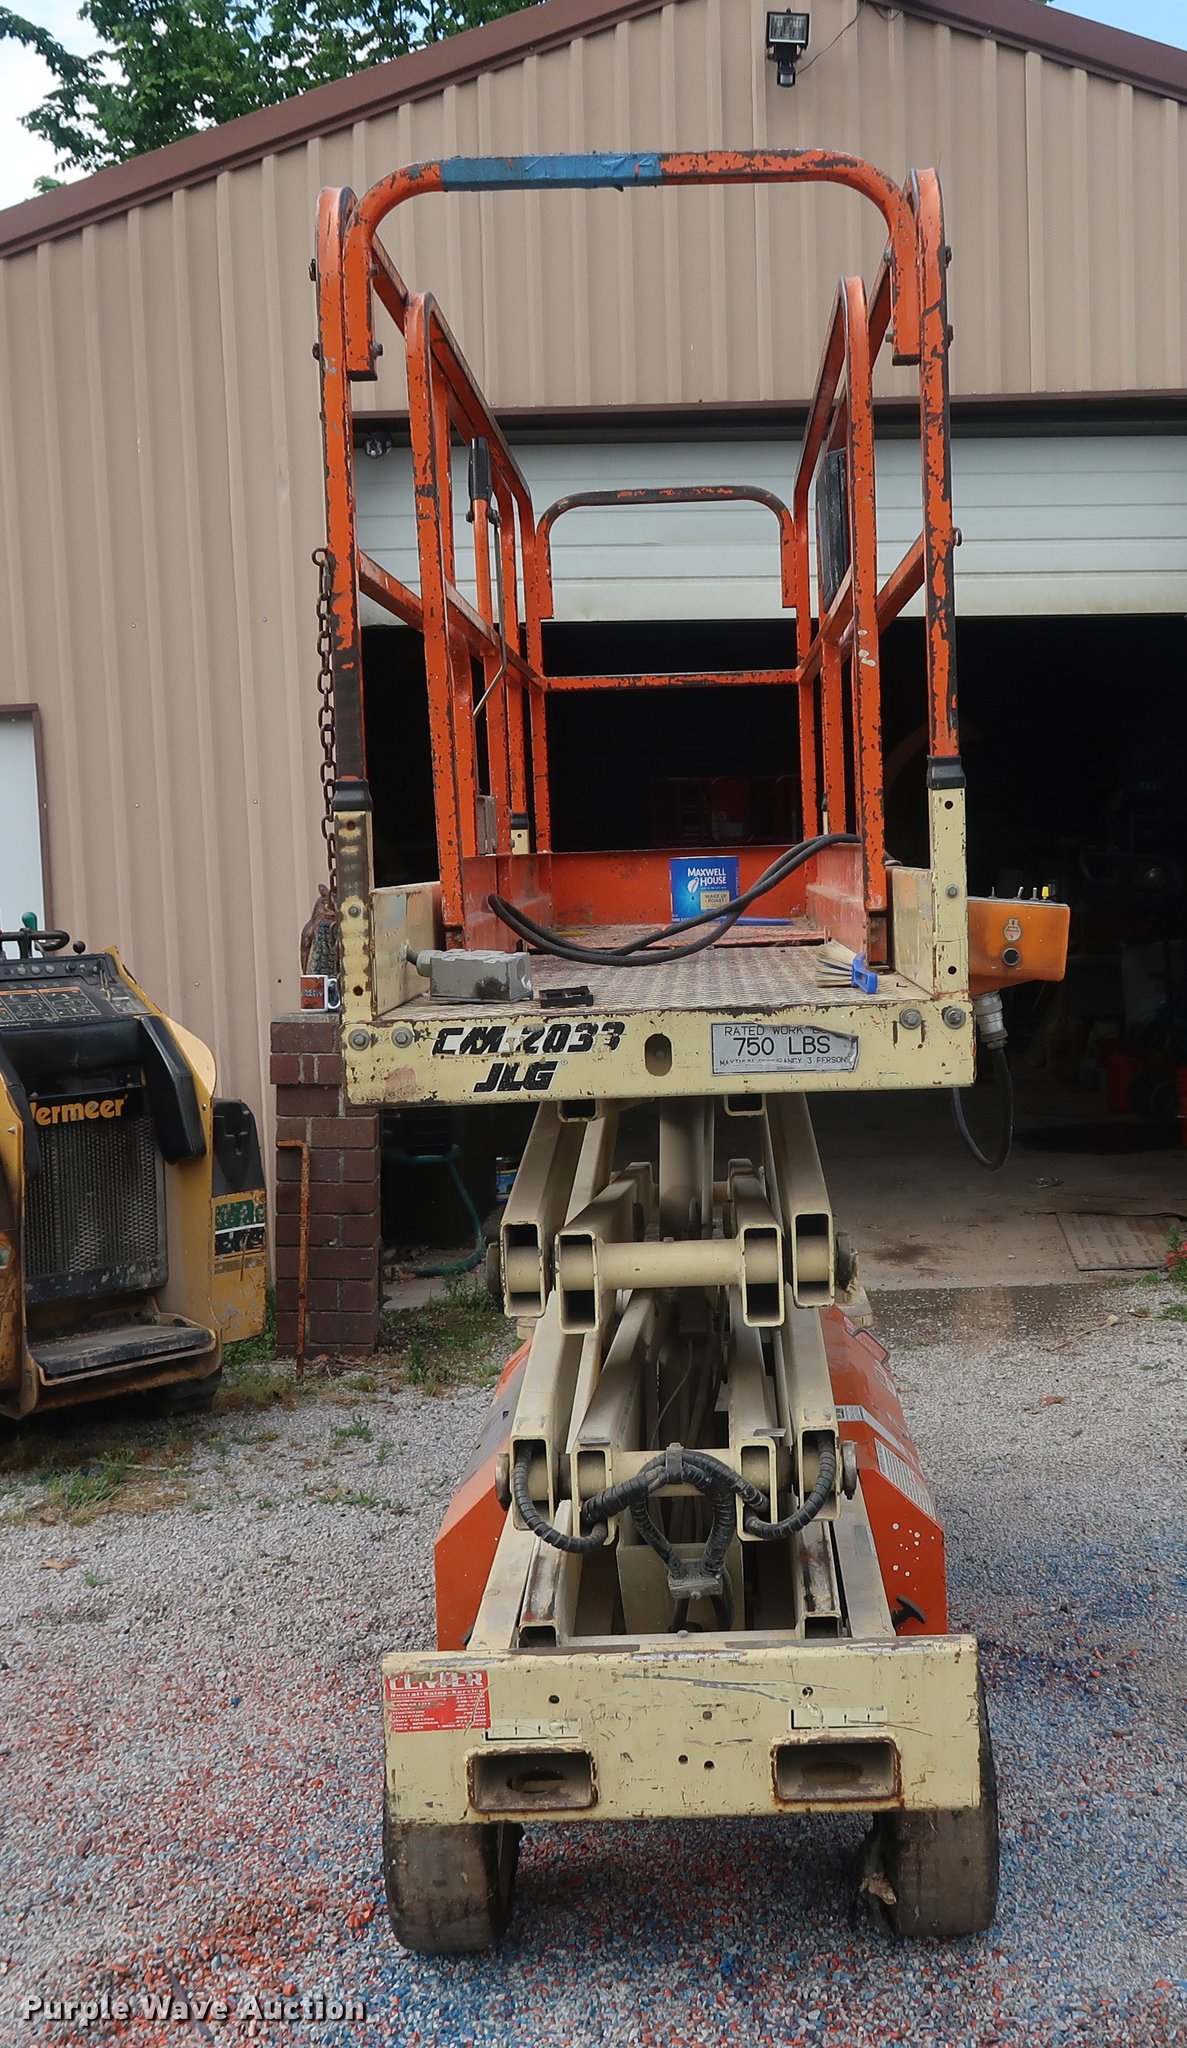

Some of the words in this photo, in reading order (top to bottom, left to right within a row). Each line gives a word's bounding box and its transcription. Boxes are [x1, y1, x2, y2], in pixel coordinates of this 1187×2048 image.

[687, 868, 727, 877] MAXWELL
[700, 876, 727, 886] HOUSE
[724, 1025, 765, 1037] RATED
[772, 1026, 804, 1035] WORK
[516, 1021, 626, 1054] 2033
[732, 1037, 774, 1057] 750
[788, 1035, 830, 1055] LBS
[806, 1057, 813, 1065] 3
[473, 1060, 559, 1093] JLG
